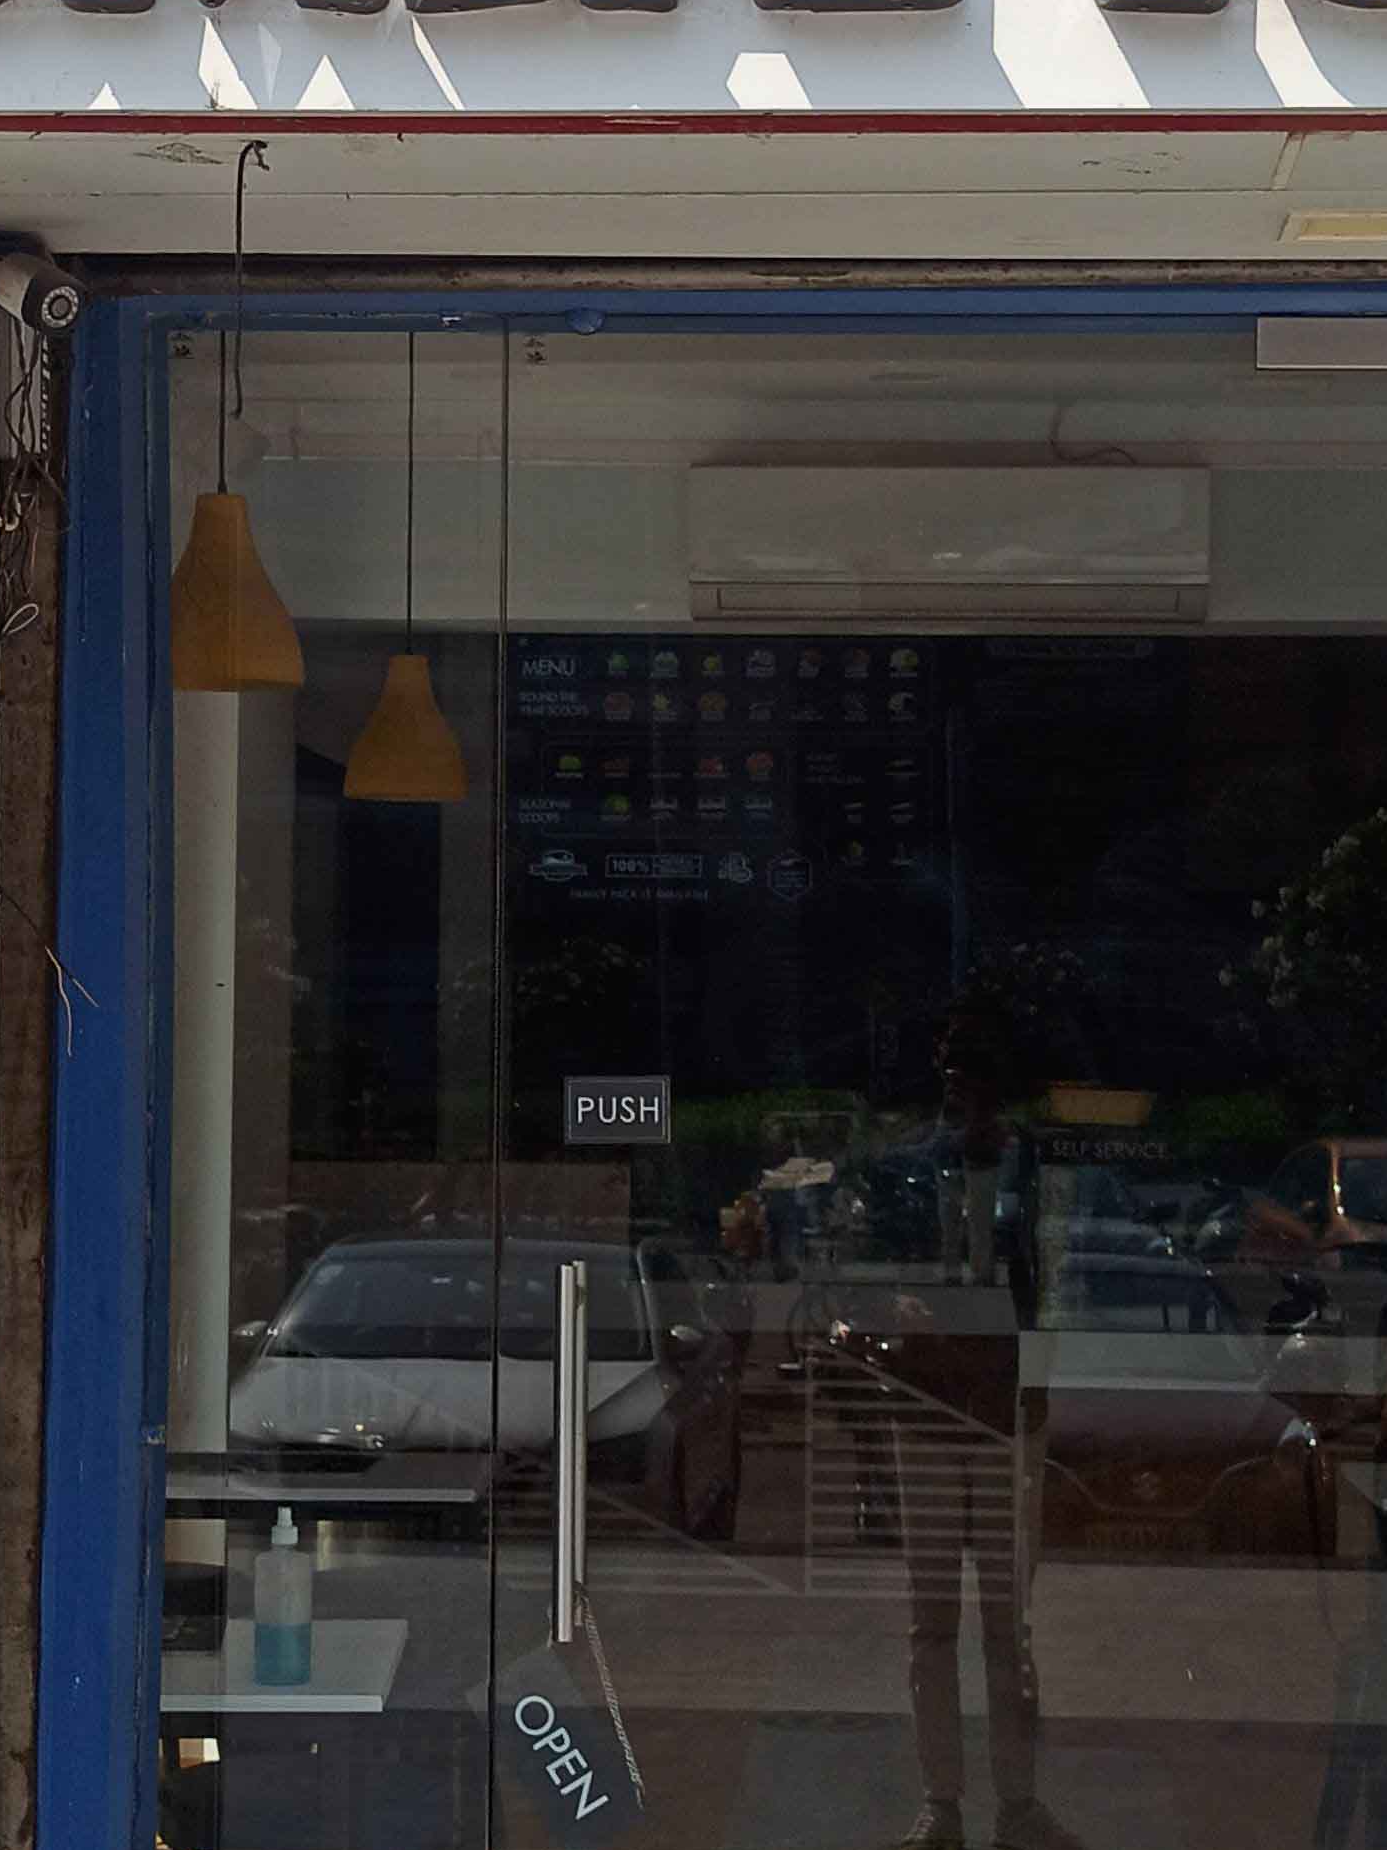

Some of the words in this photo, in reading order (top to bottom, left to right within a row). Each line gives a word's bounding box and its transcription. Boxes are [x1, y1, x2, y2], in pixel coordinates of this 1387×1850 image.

[577, 1096, 659, 1124] PUSH
[1093, 1141, 1166, 1160] SERVICE
[515, 1695, 610, 1821] OPEN
